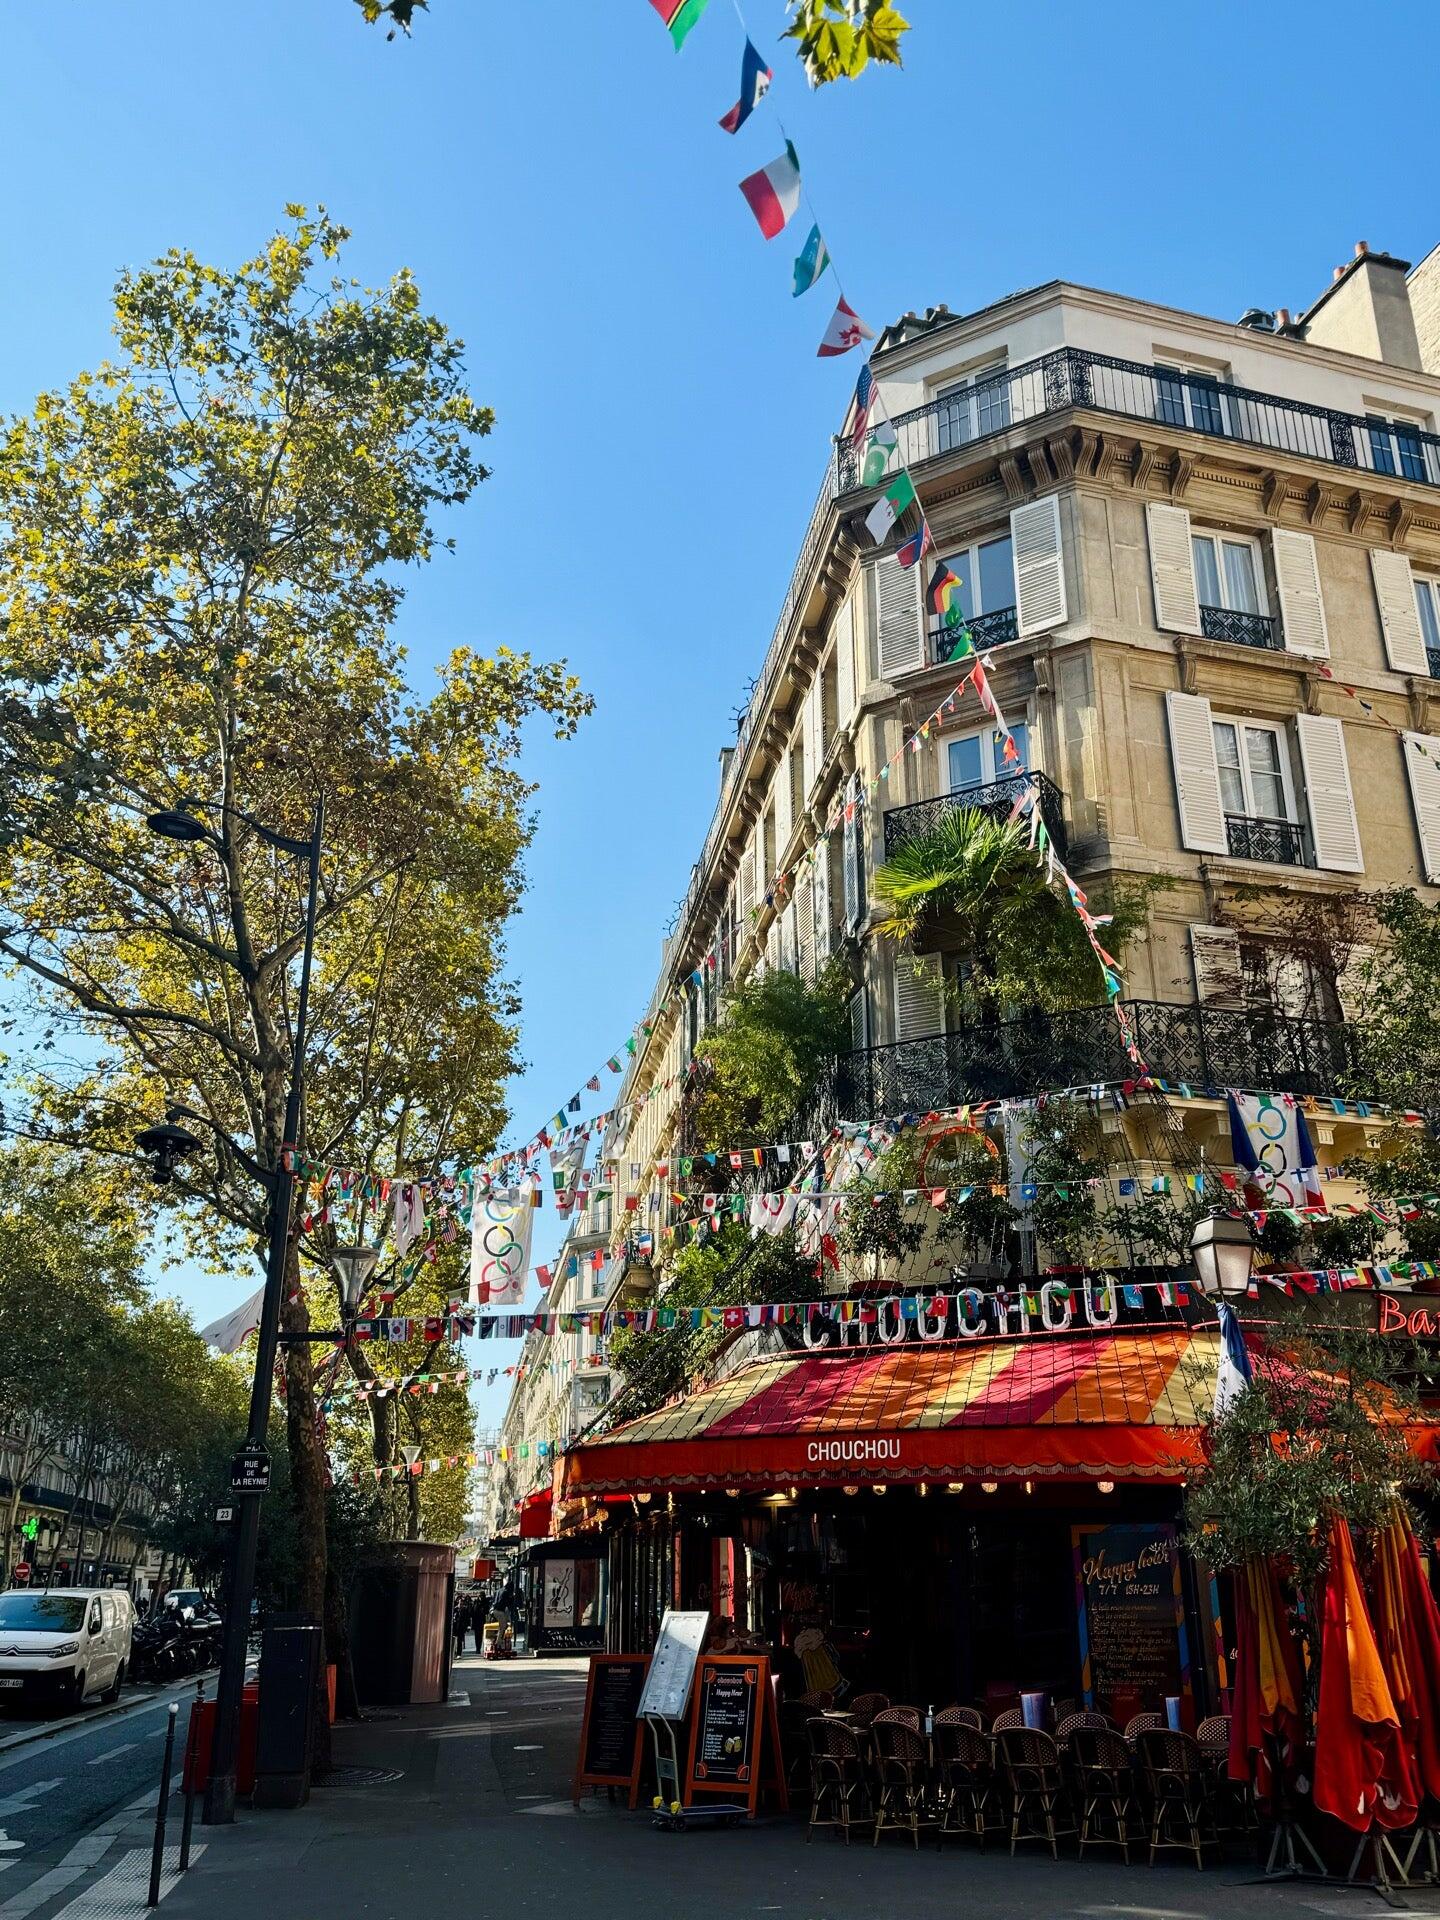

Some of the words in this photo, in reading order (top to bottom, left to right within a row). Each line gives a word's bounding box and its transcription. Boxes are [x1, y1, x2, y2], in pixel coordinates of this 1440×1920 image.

[802, 1275, 1118, 1350] CHOUCHOU
[807, 1438, 901, 1461] CHOUCHOU
[244, 1460, 259, 1468] RUE
[232, 1478, 242, 1486] LA
[242, 1477, 268, 1486] REYNIE
[220, 1511, 229, 1519] 23
[1083, 1549, 1137, 1585] Happy
[1098, 1584, 1118, 1596] 7/7
[715, 1688, 731, 1698] Happy
